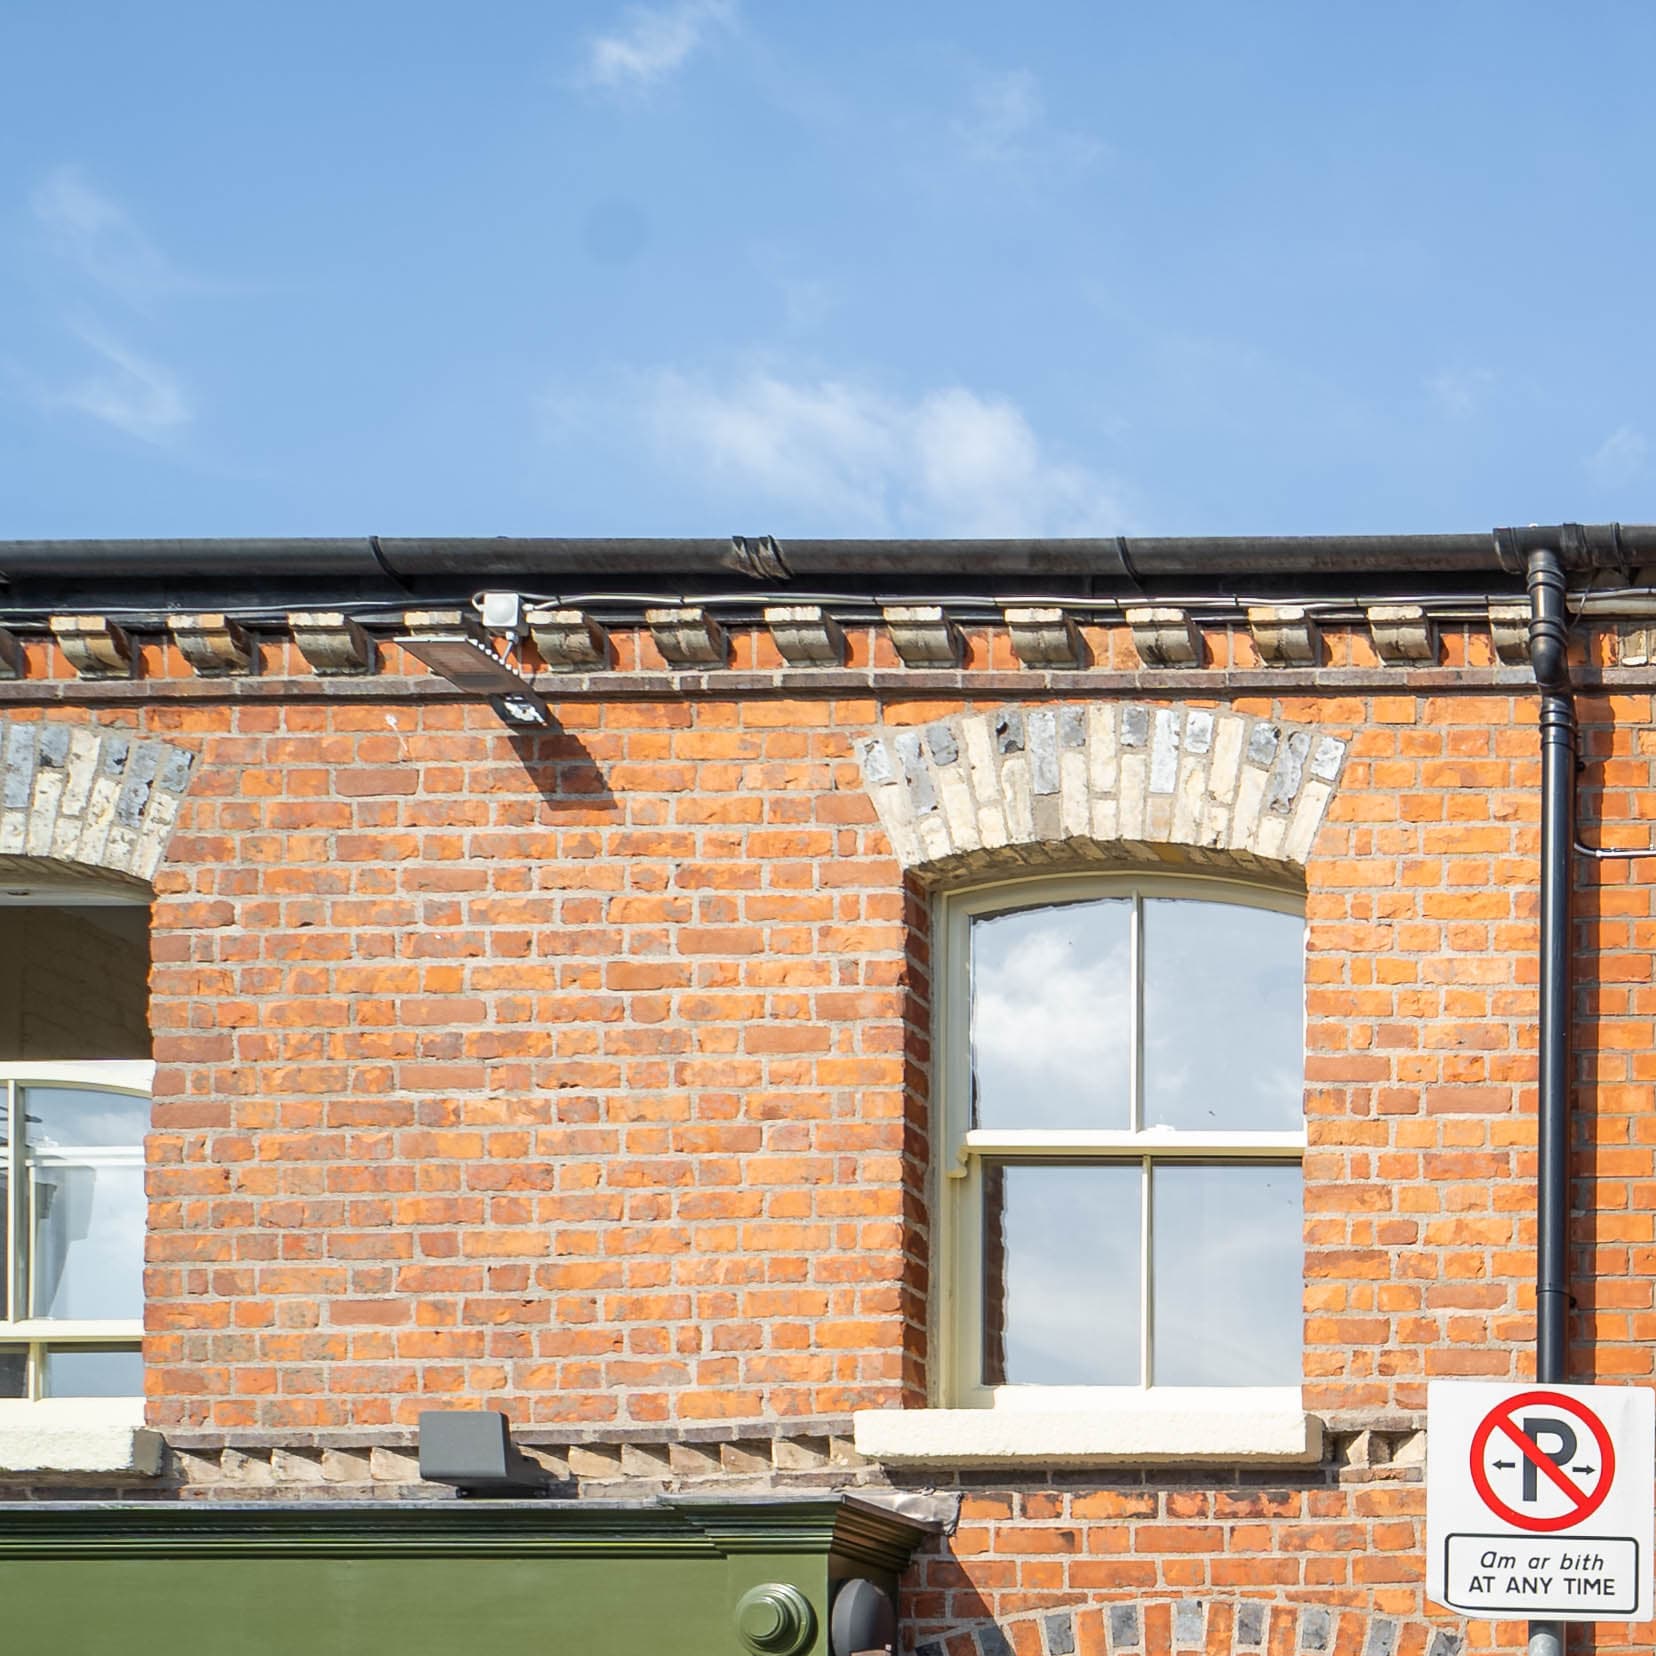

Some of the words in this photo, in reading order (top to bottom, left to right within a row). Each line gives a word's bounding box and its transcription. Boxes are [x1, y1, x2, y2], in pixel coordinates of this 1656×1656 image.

[1528, 1556, 1550, 1570] ar
[1560, 1553, 1604, 1571] bith
[1468, 1576, 1496, 1593] AT
[1506, 1576, 1553, 1595] ANY
[1564, 1577, 1616, 1596] TIME
